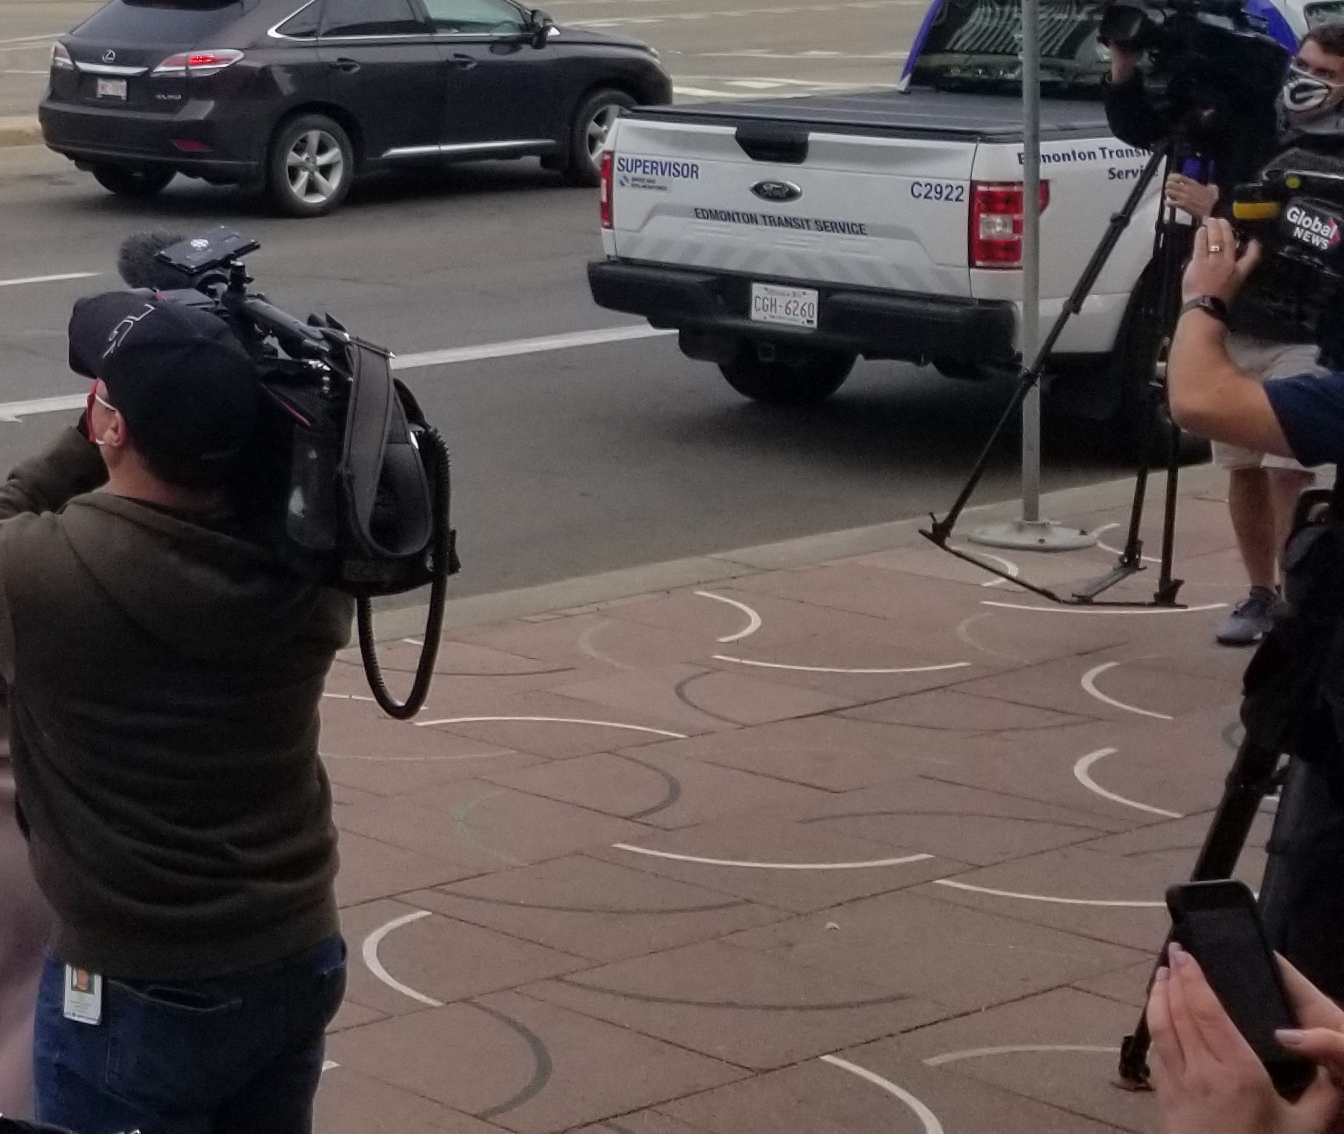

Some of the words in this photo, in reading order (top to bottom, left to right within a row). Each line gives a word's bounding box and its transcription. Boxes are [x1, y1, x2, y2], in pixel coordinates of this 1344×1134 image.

[617, 157, 700, 179] SUPERVISOR
[1017, 150, 1097, 165] Emonton
[910, 181, 965, 202] C2922
[694, 207, 759, 225] EDMONTON
[761, 214, 812, 230] TRANSIT
[814, 219, 868, 236] SERVICE
[1286, 206, 1338, 239] Global
[1293, 226, 1330, 250] NEWS
[754, 294, 815, 318] CGH-6260
